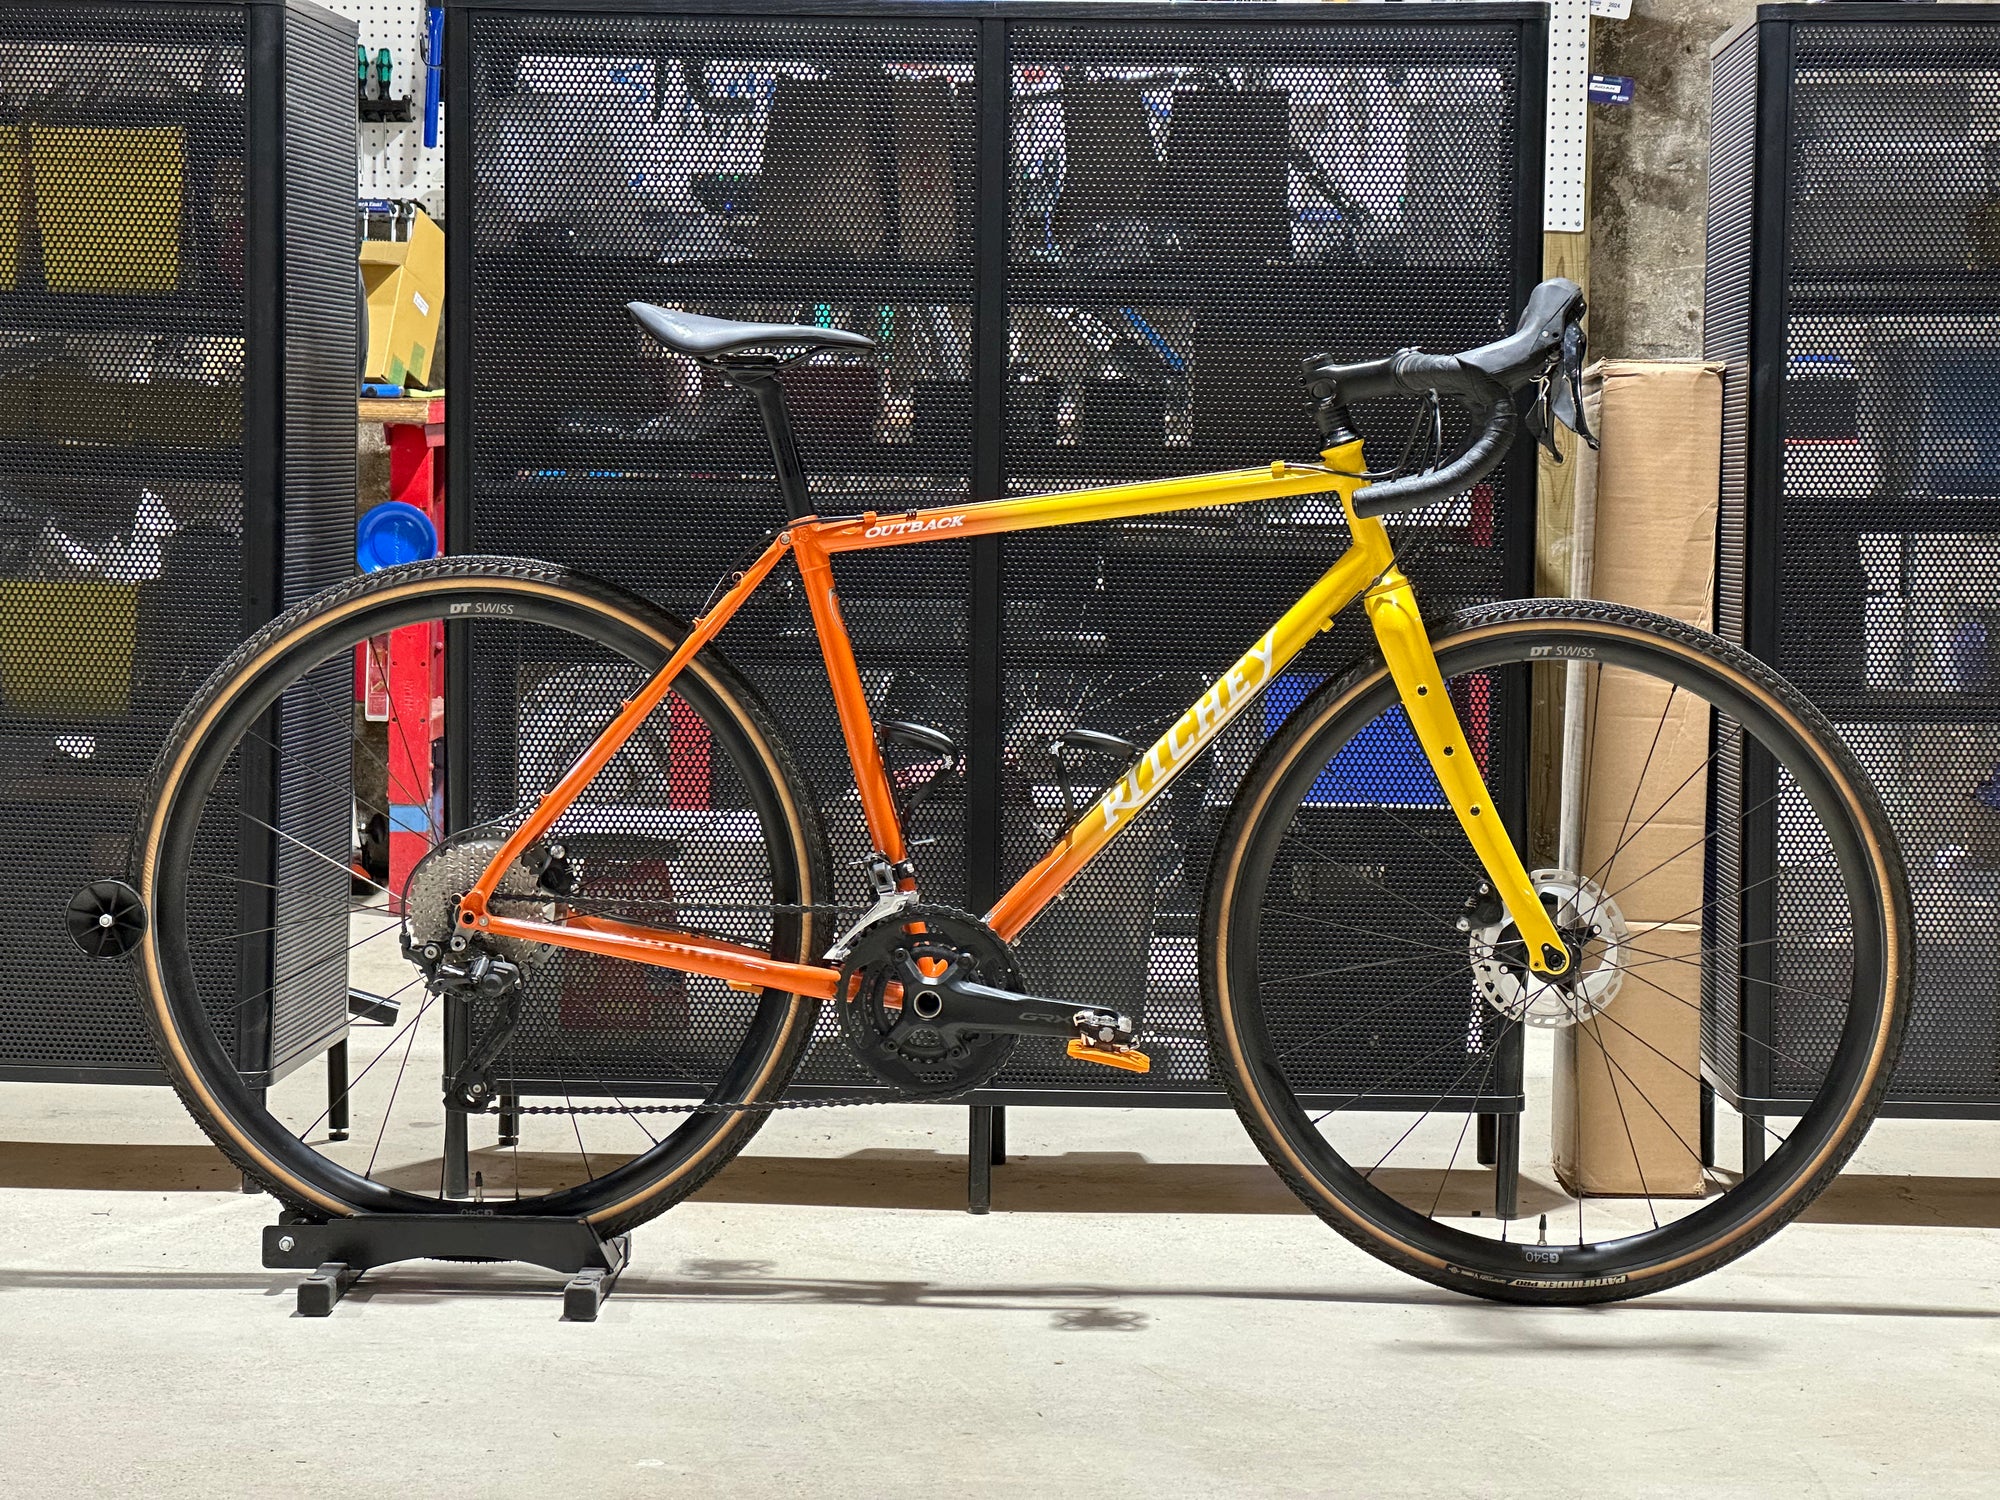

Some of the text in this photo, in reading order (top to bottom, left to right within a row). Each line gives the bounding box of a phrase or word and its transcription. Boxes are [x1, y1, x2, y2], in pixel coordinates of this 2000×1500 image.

[864, 514, 967, 538] OUTBACK
[450, 602, 515, 615] DT SWISS
[1530, 645, 1596, 658] DT SWISS
[1103, 626, 1279, 832] RITCHEY
[1019, 1012, 1072, 1025] GRX
[1525, 1251, 1560, 1264] G540
[1516, 1274, 1627, 1289] PATHFINDER PRO
